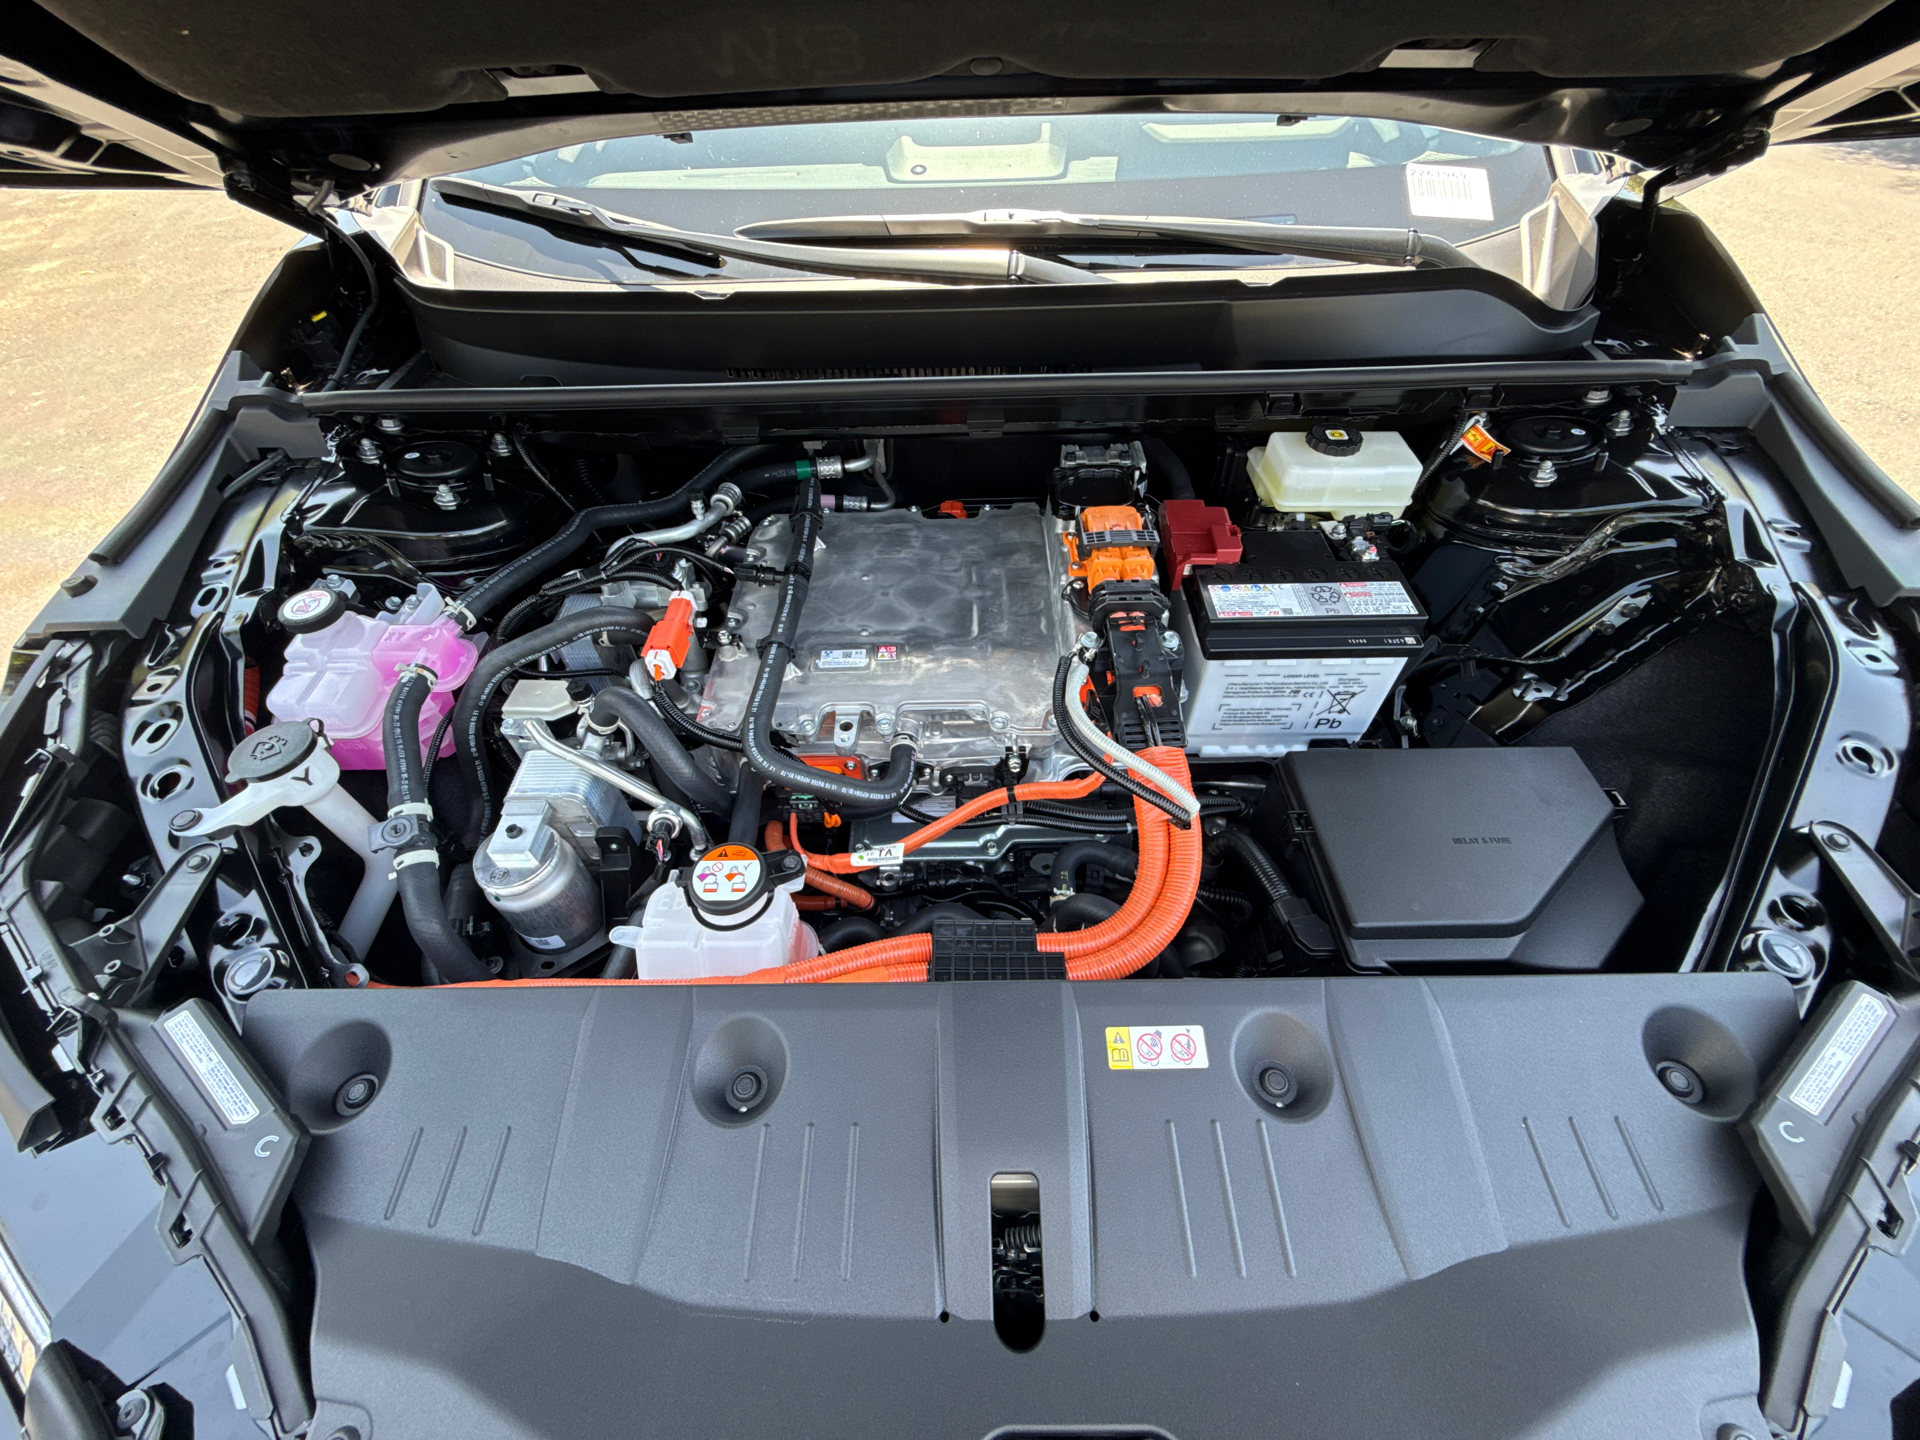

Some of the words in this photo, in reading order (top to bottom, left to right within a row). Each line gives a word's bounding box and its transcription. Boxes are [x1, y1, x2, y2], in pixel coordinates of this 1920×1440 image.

[383, 631, 408, 642] XY
[1314, 718, 1342, 729] Pb
[290, 765, 313, 786] Y
[1452, 837, 1480, 845] RELAY
[1778, 1121, 1805, 1143] C
[254, 1135, 279, 1157] C
